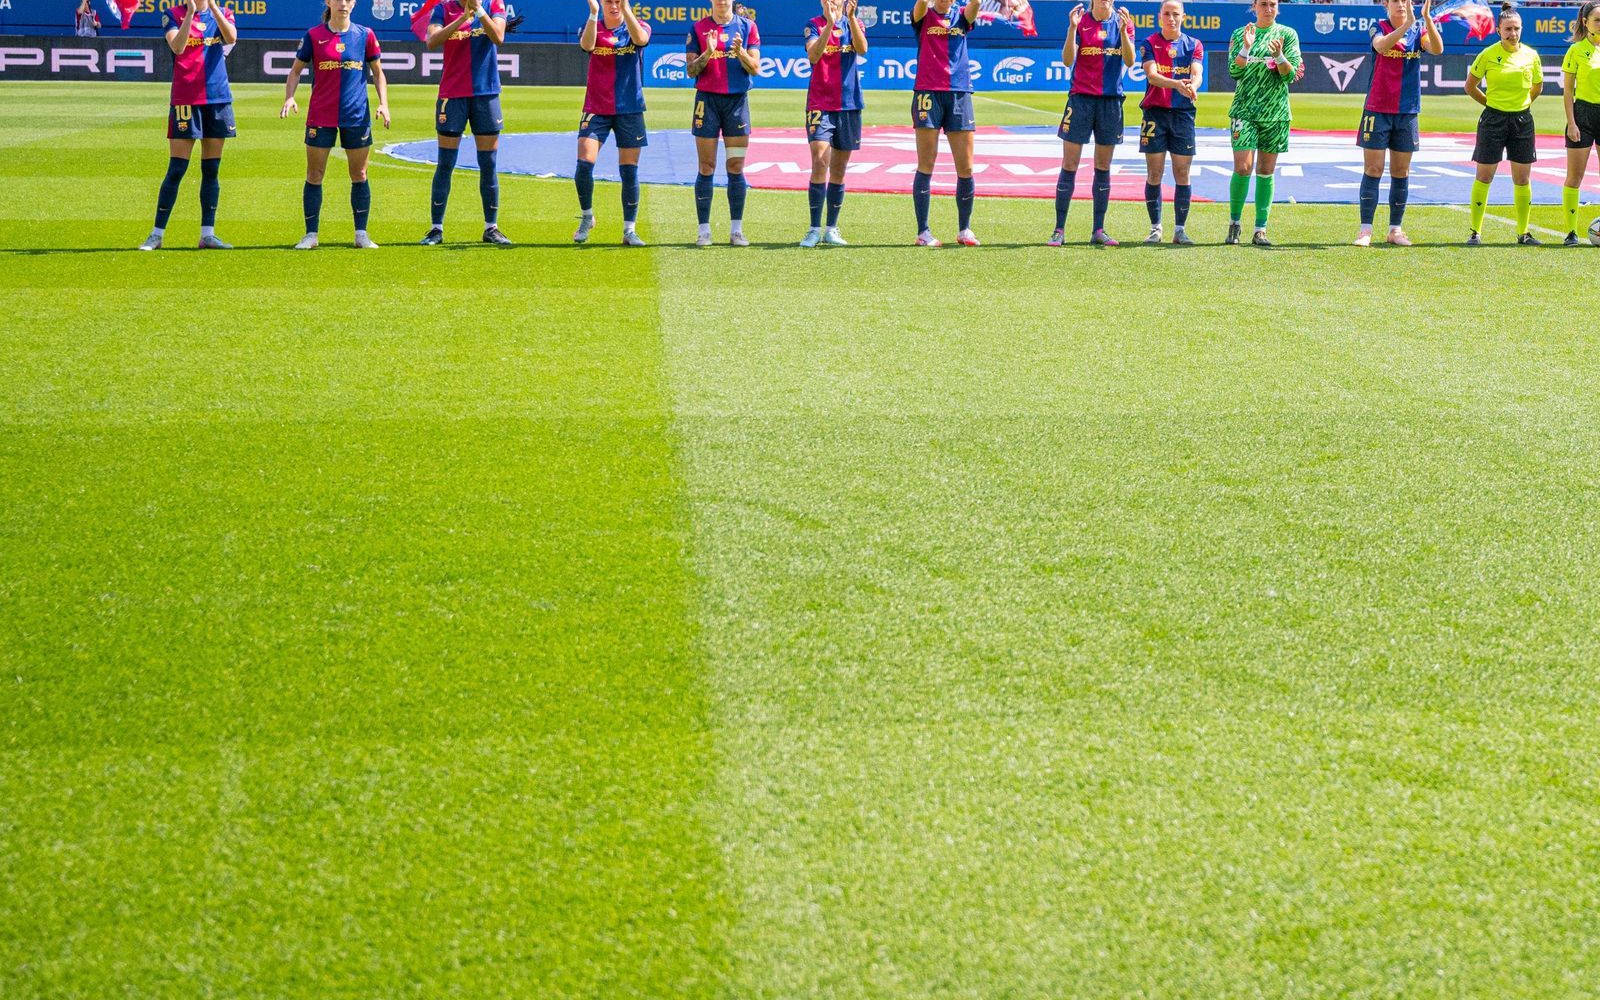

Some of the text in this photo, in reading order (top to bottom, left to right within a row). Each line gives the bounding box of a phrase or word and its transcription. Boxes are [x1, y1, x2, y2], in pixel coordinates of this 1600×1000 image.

[224, 0, 266, 14] CLUB
[634, 3, 651, 21] ÉS
[655, 7, 686, 22] QUE
[882, 11, 900, 24] FC
[1183, 16, 1221, 29] CLUB
[1339, 18, 1356, 31] FC
[1535, 16, 1565, 33] MÉS
[660, 68, 685, 81] Liga
[1000, 73, 1033, 84] Liga F
[441, 98, 449, 113] 7
[695, 100, 705, 118] 4
[917, 94, 932, 110] 16
[175, 104, 192, 120] 10
[1063, 107, 1073, 123] 2
[1140, 120, 1155, 137] 22
[1363, 115, 1375, 132] 11
